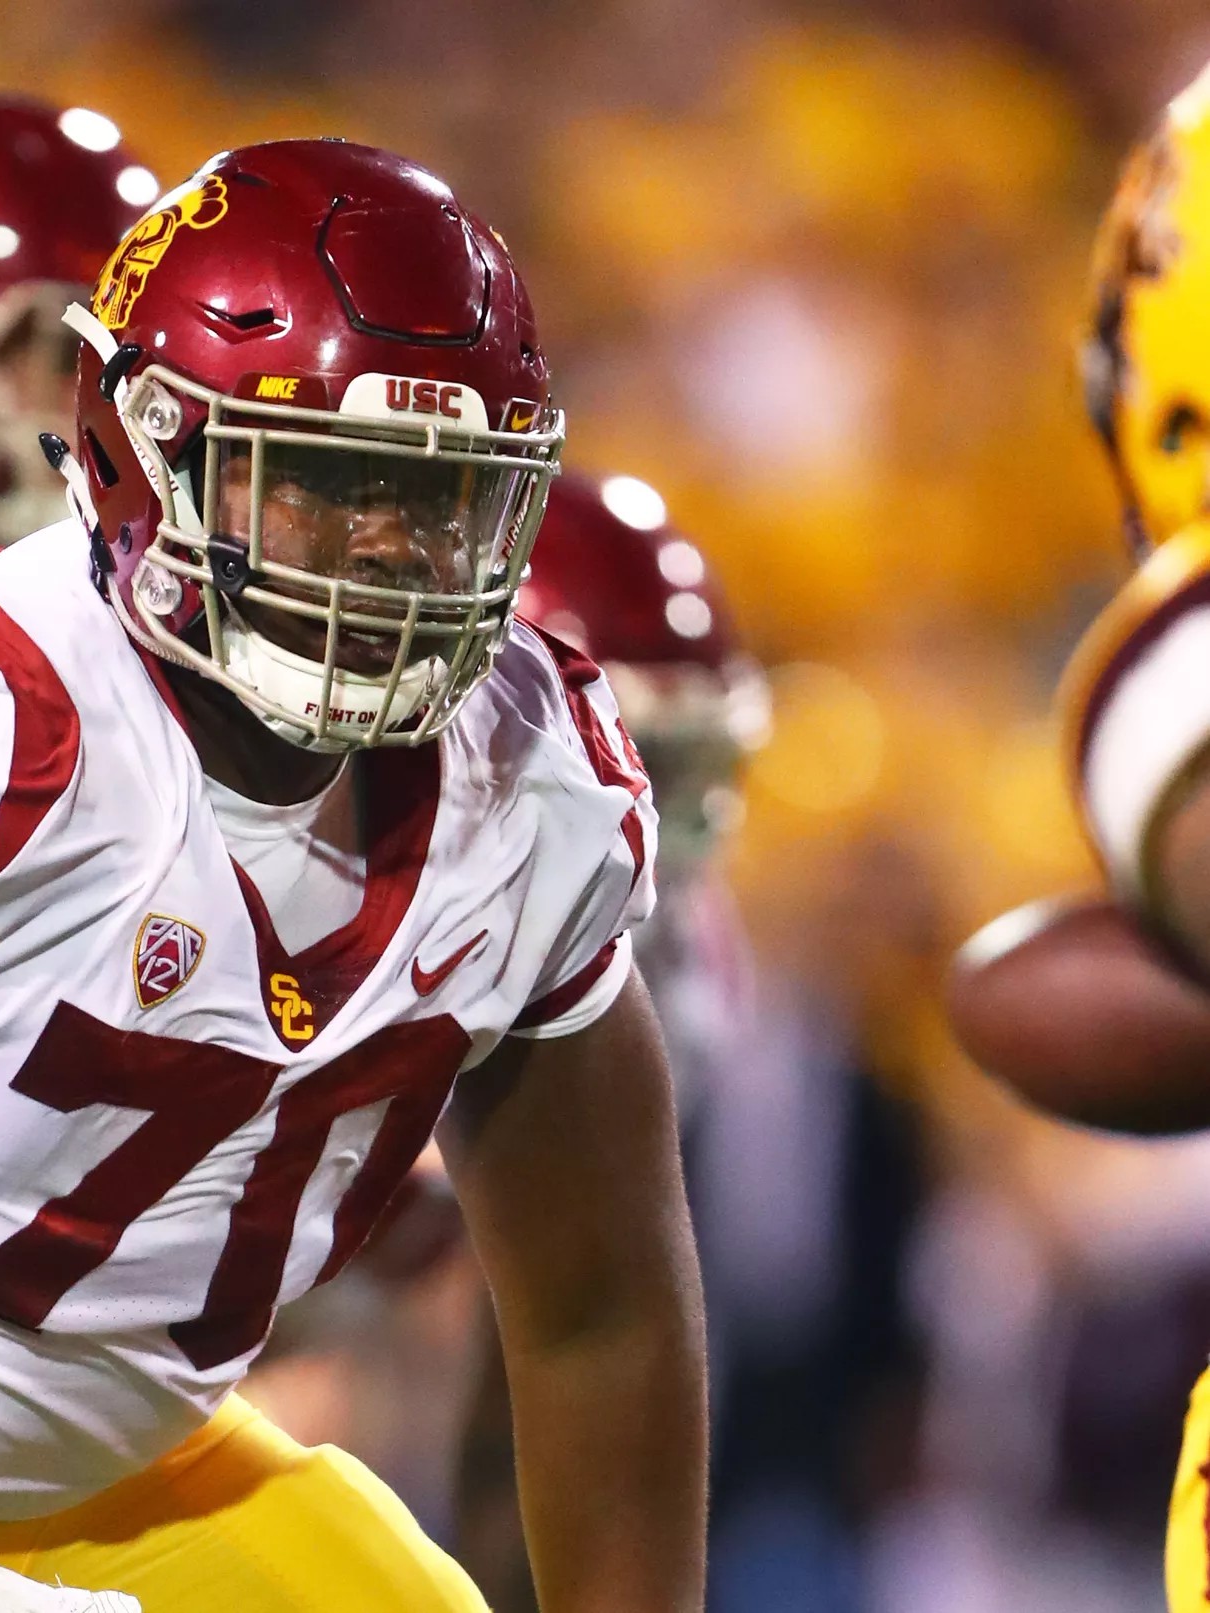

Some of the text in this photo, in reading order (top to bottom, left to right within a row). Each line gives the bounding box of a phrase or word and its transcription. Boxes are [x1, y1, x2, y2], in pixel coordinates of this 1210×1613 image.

[255, 376, 300, 399] NIKE
[385, 379, 462, 419] USC
[140, 955, 178, 993] 12
[269, 972, 314, 1040] SC
